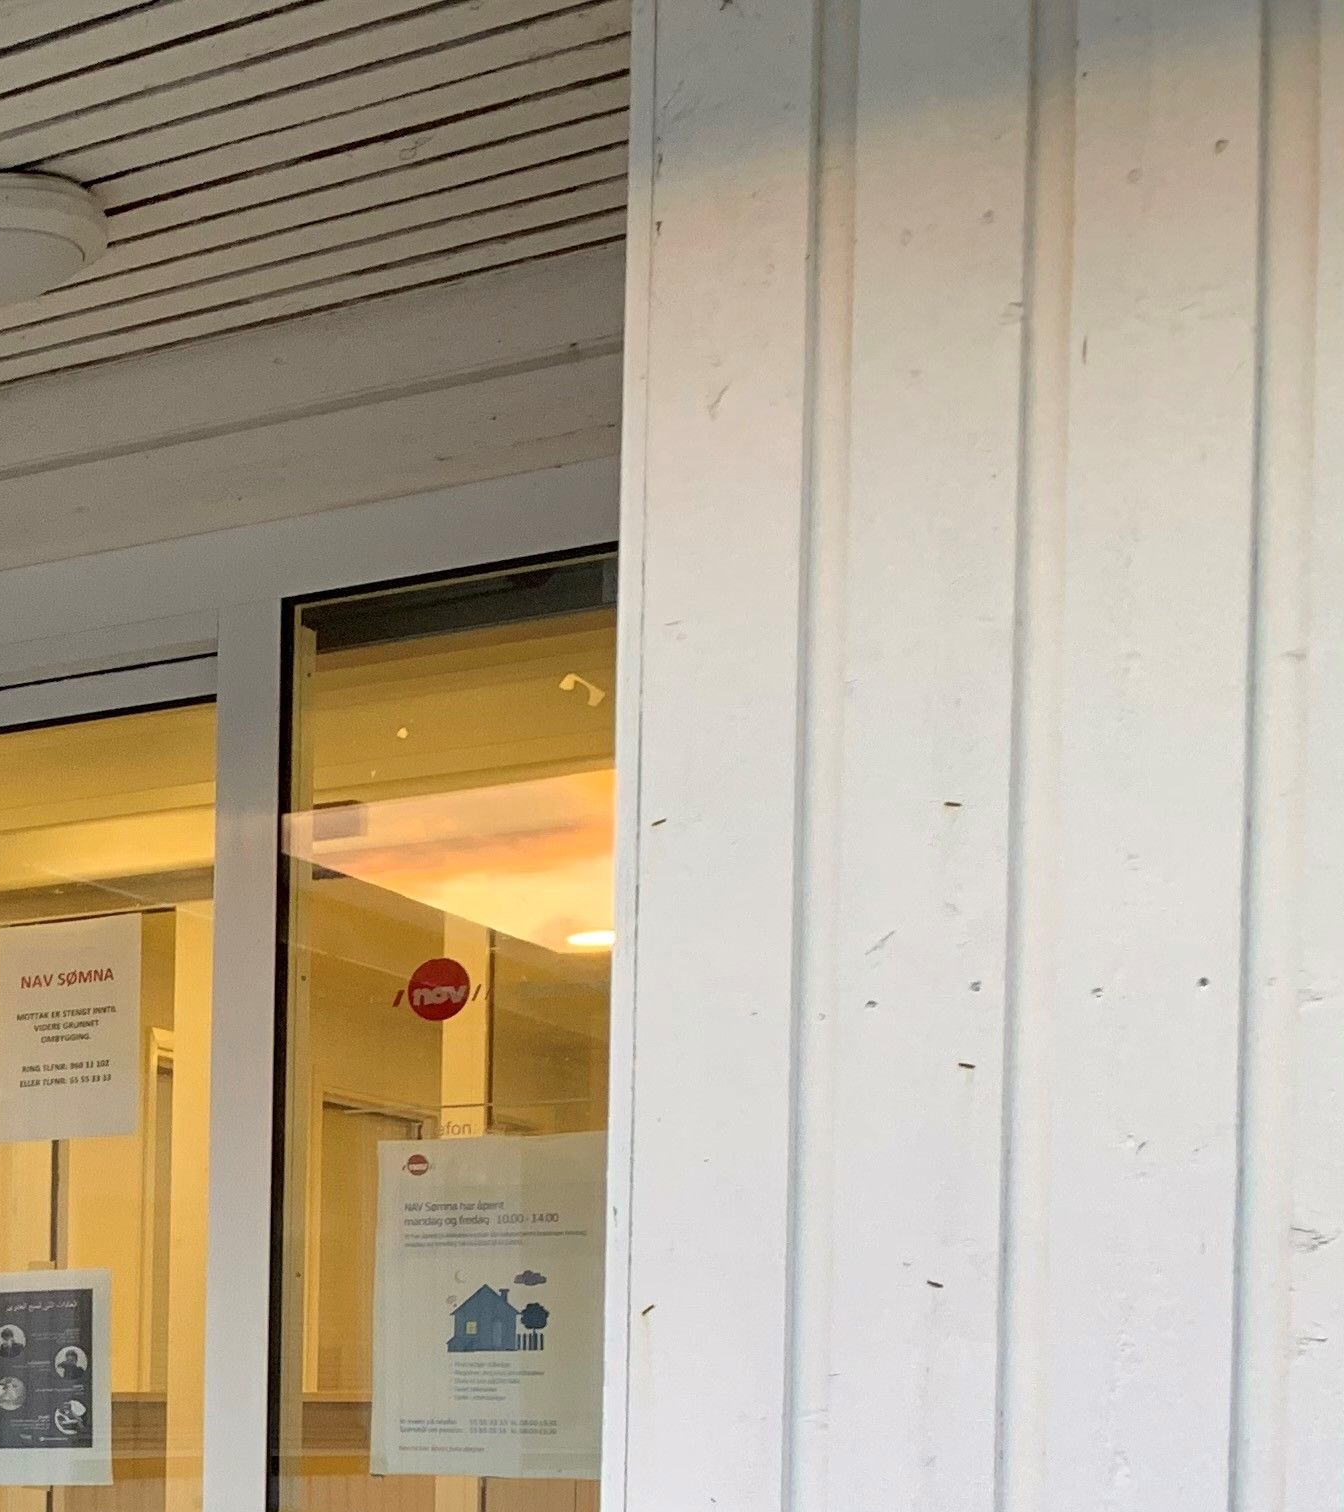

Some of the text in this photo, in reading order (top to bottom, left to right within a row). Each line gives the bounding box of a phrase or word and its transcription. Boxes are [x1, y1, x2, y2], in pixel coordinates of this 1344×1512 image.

[20, 968, 115, 989] NAV SØMNA
[16, 1011, 49, 1021] MOTTAK
[51, 1010, 61, 1018] ER
[63, 1007, 91, 1017] STENGT
[34, 1019, 99, 1032] VIDERE GRUNNET
[444, 1217, 458, 1228] og
